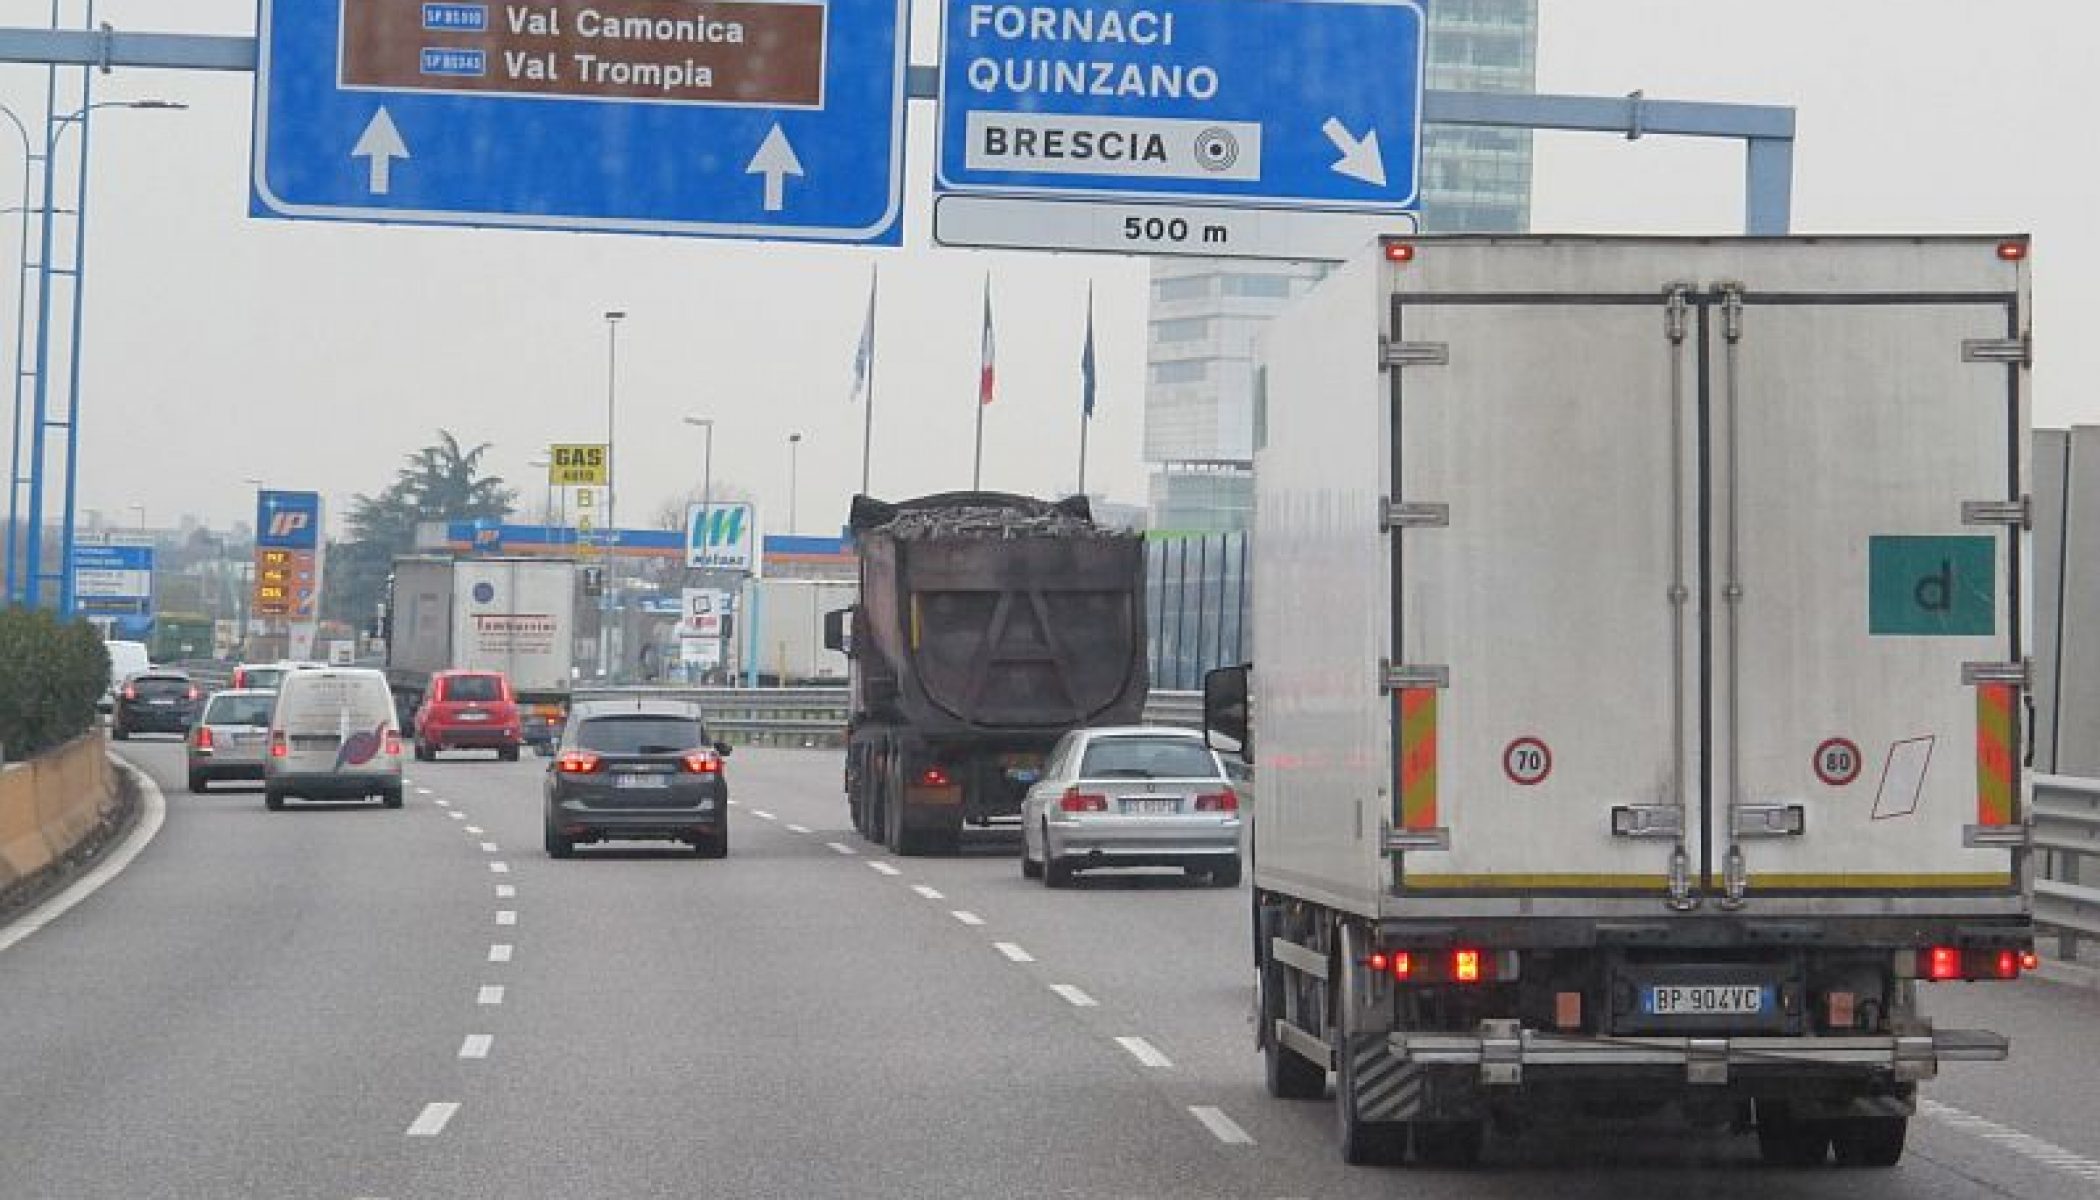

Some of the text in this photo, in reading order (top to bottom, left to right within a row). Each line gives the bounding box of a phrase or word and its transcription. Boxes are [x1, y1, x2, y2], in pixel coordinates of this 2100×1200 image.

[505, 6, 744, 44] Val Camonica
[968, 4, 1174, 45] FORNACI
[505, 49, 713, 89] Val Trompia
[967, 57, 1219, 100] QUINZANO
[984, 126, 1167, 163] BRESCIA
[1124, 217, 1227, 243] 500 m
[556, 448, 602, 466] GAS
[268, 511, 308, 536] IP
[1915, 556, 1951, 611] d
[1517, 751, 1540, 770] 70
[1826, 752, 1849, 771] 80
